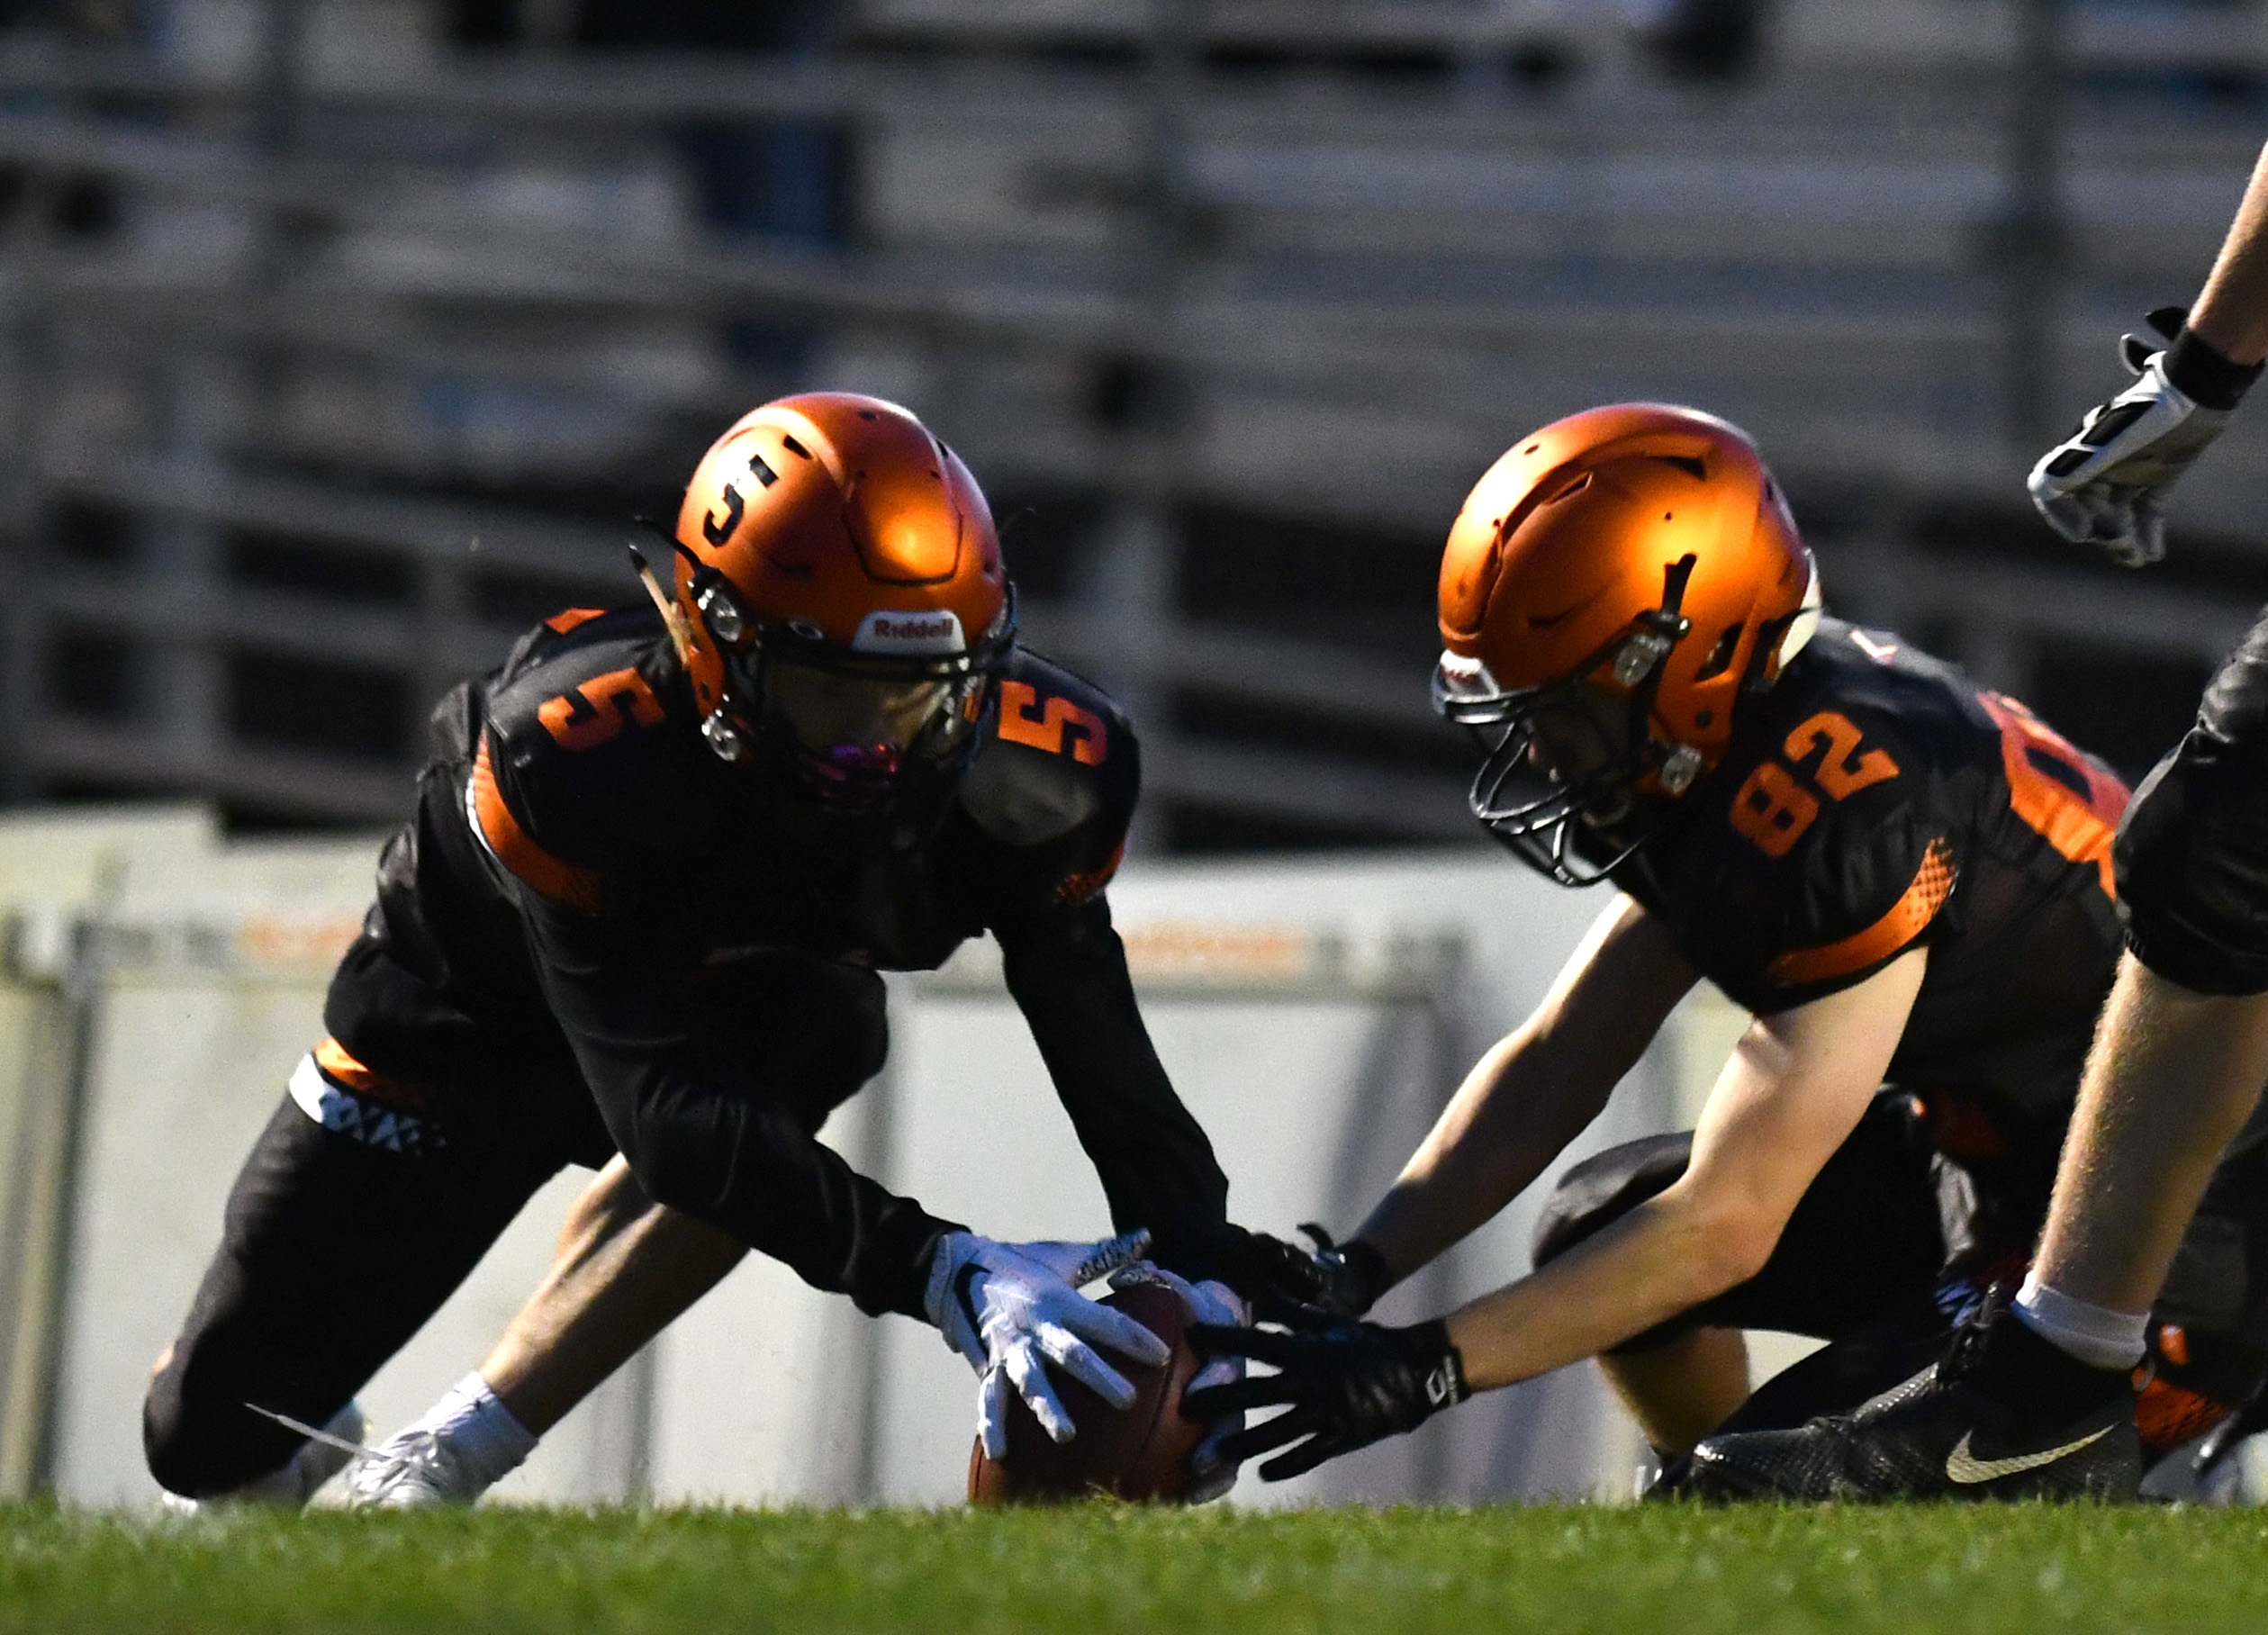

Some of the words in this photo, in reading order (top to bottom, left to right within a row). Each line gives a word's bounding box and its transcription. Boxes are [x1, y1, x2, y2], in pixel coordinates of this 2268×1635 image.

[874, 618, 954, 638] Riddell
[538, 666, 665, 751] 5
[998, 680, 1107, 766] 5
[1731, 711, 1901, 857] 82
